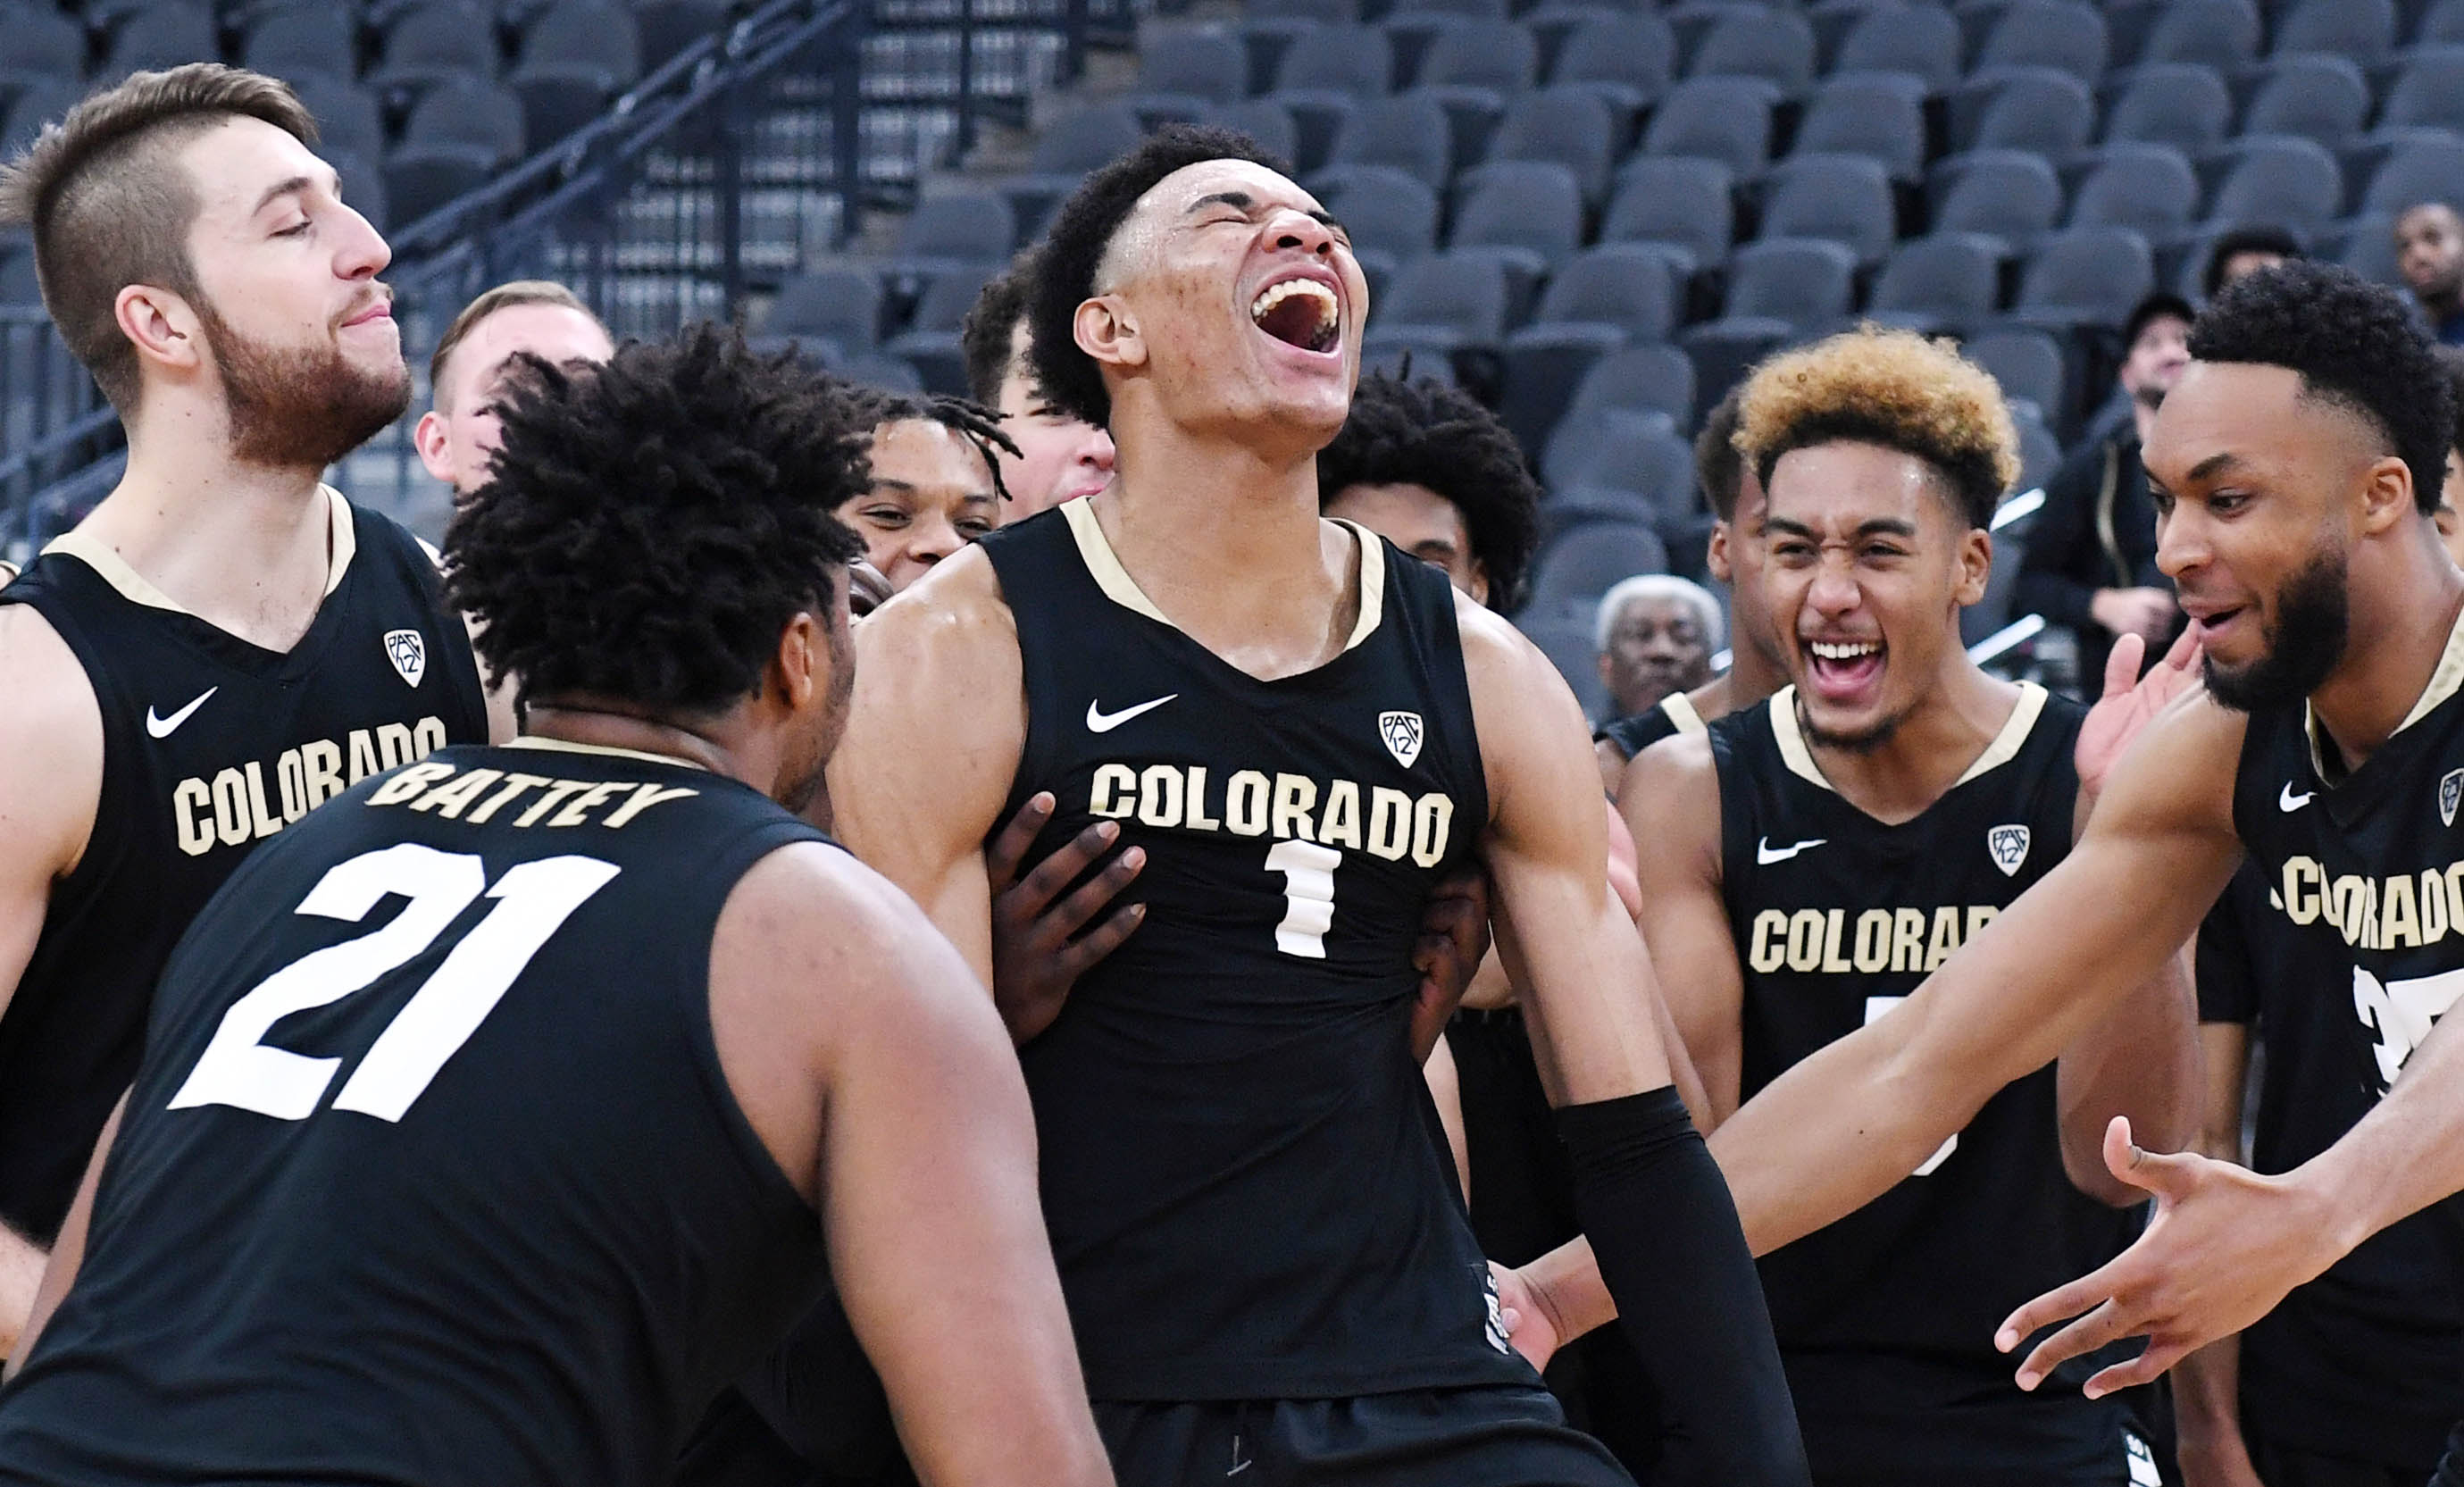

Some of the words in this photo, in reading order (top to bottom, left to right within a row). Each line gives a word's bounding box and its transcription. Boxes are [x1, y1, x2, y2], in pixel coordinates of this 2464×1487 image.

[388, 633, 422, 664] PAC
[397, 654, 419, 672] 12
[1382, 715, 1419, 745] PAC
[1393, 737, 1412, 756] 12
[364, 762, 700, 829] BATTEY
[1089, 764, 1454, 867] COLORADO
[1992, 829, 2027, 855] PAC
[2000, 847, 2019, 864] 12
[1264, 839, 1342, 959] 1
[1750, 905, 2000, 973] COLORA
[166, 842, 622, 1124] 21
